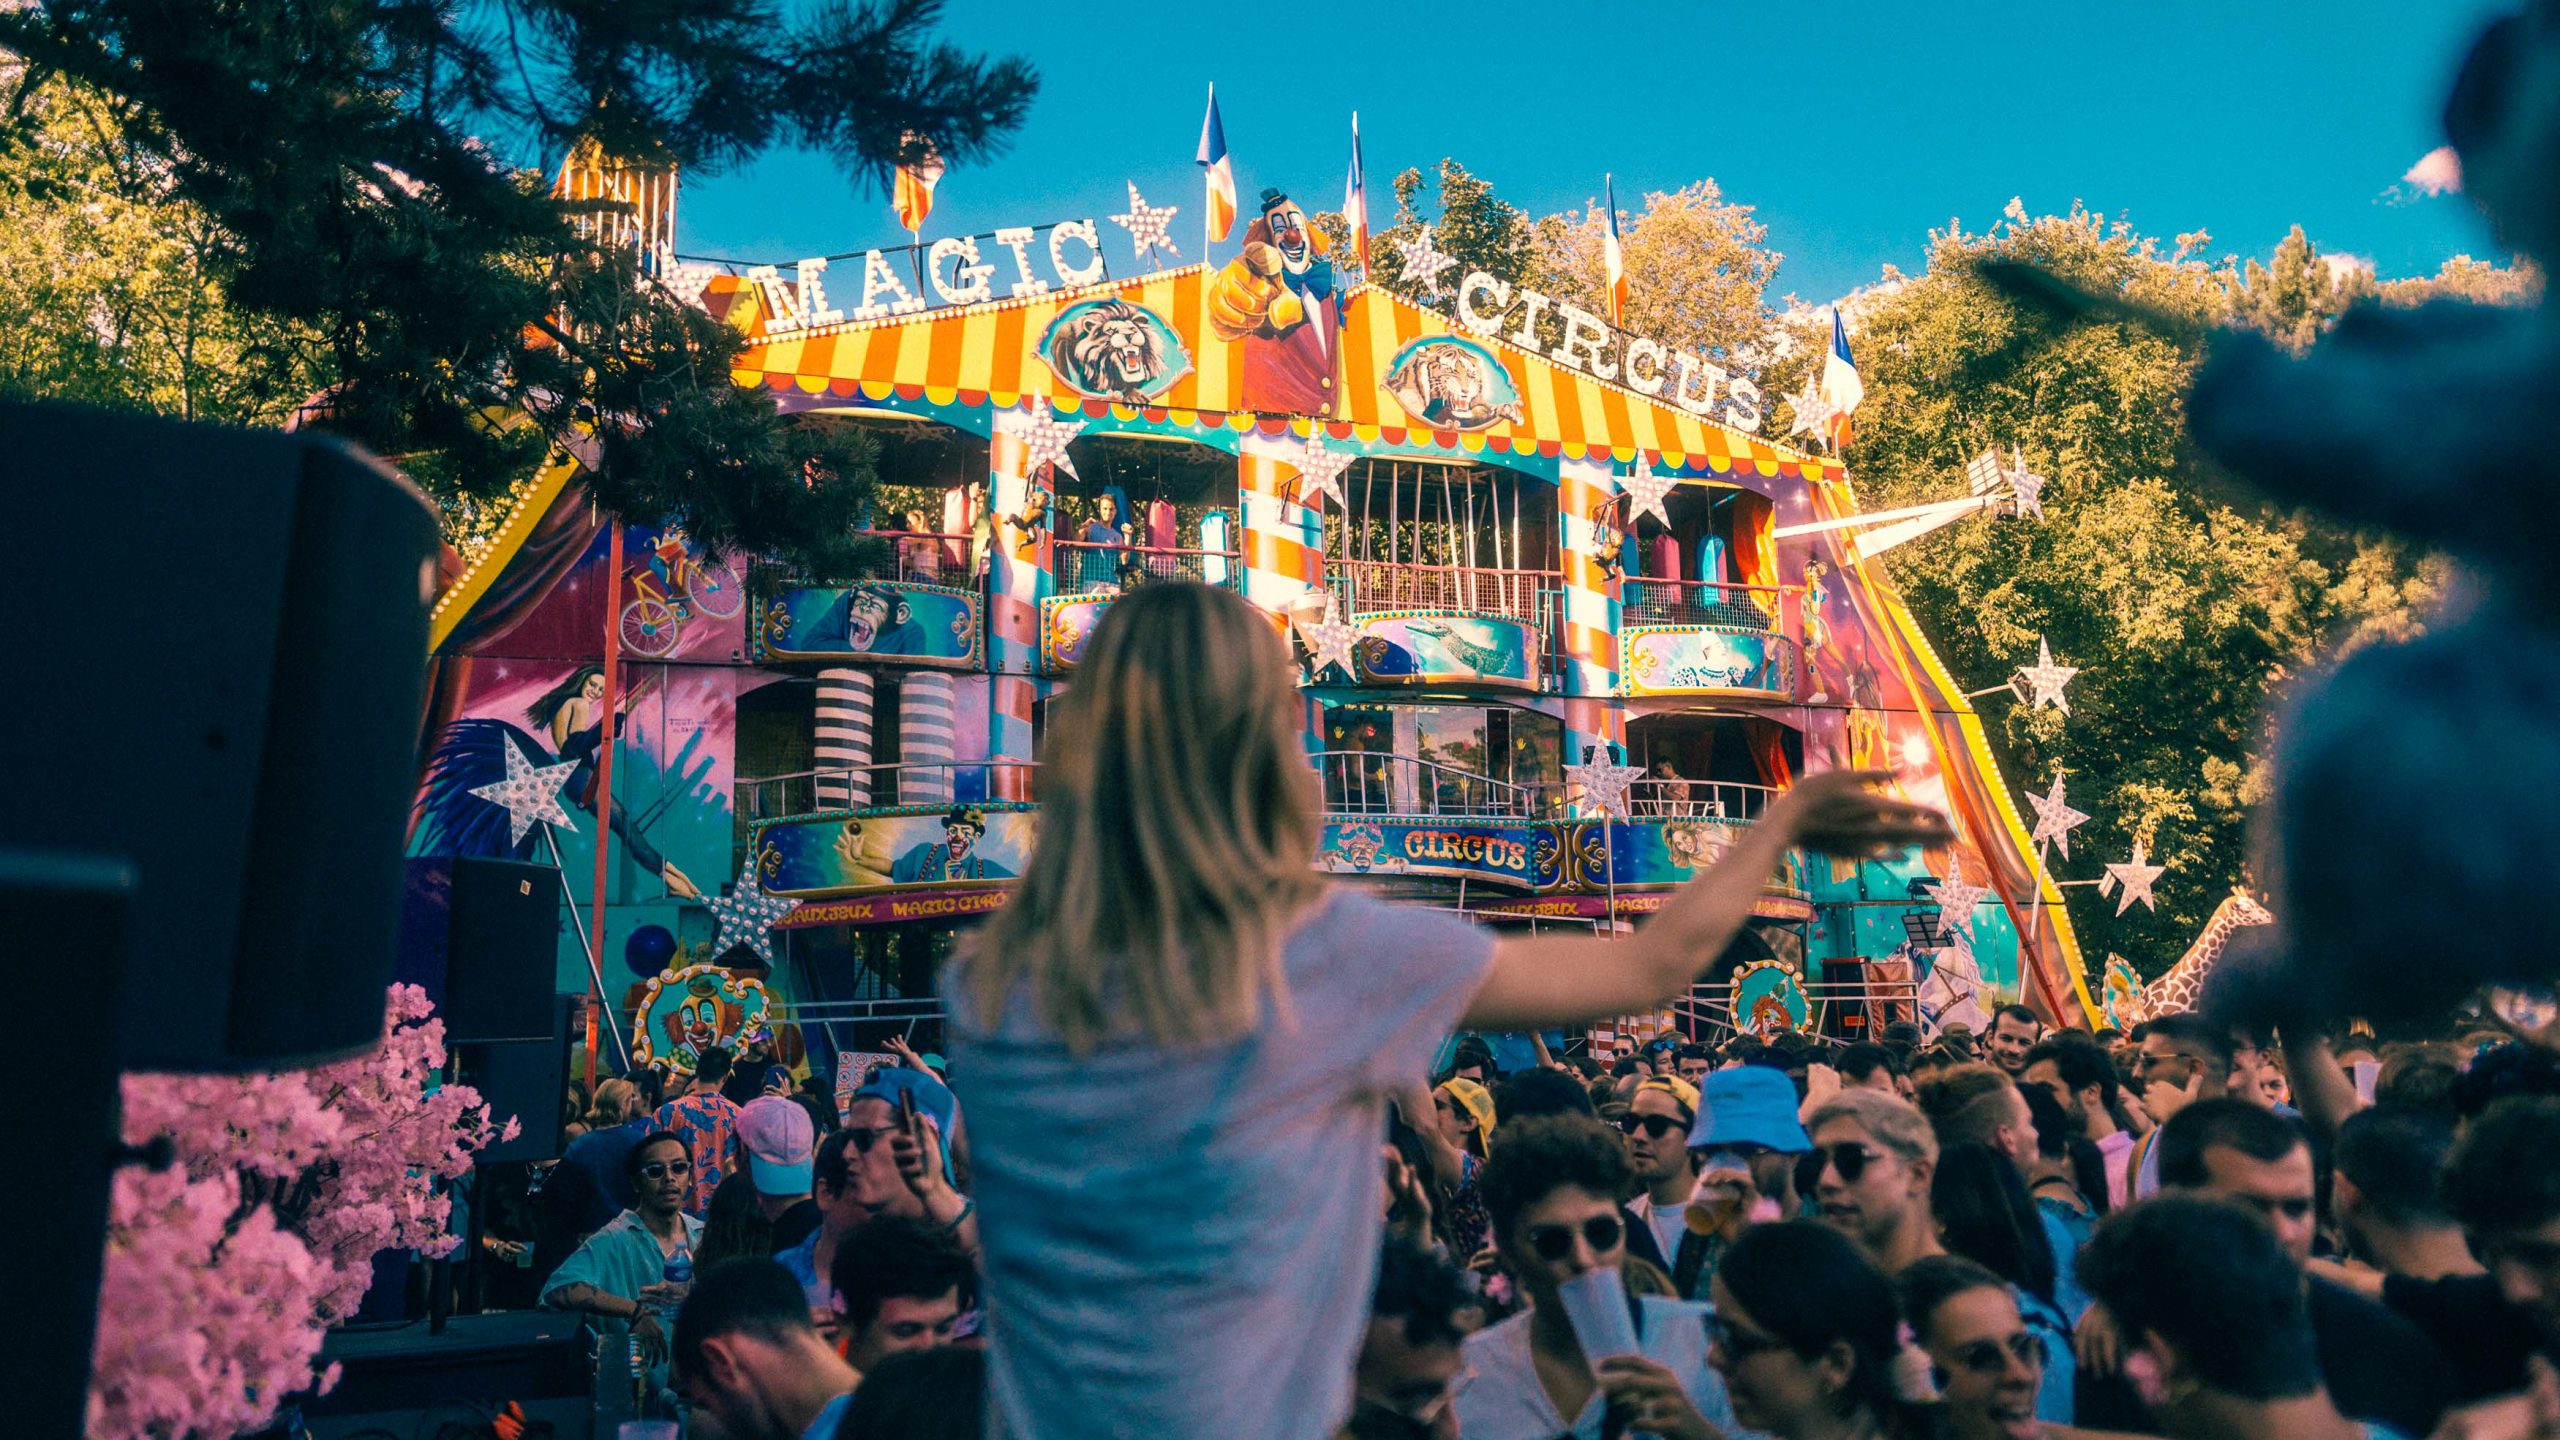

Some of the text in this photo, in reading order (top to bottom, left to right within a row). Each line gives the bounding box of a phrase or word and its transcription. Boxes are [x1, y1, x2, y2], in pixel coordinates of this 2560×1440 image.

[749, 219, 1106, 335] MAGIC
[1457, 271, 1763, 433] CIRCUS
[1405, 830, 1526, 870] CIRCUS
[892, 898, 956, 917] MAGIC
